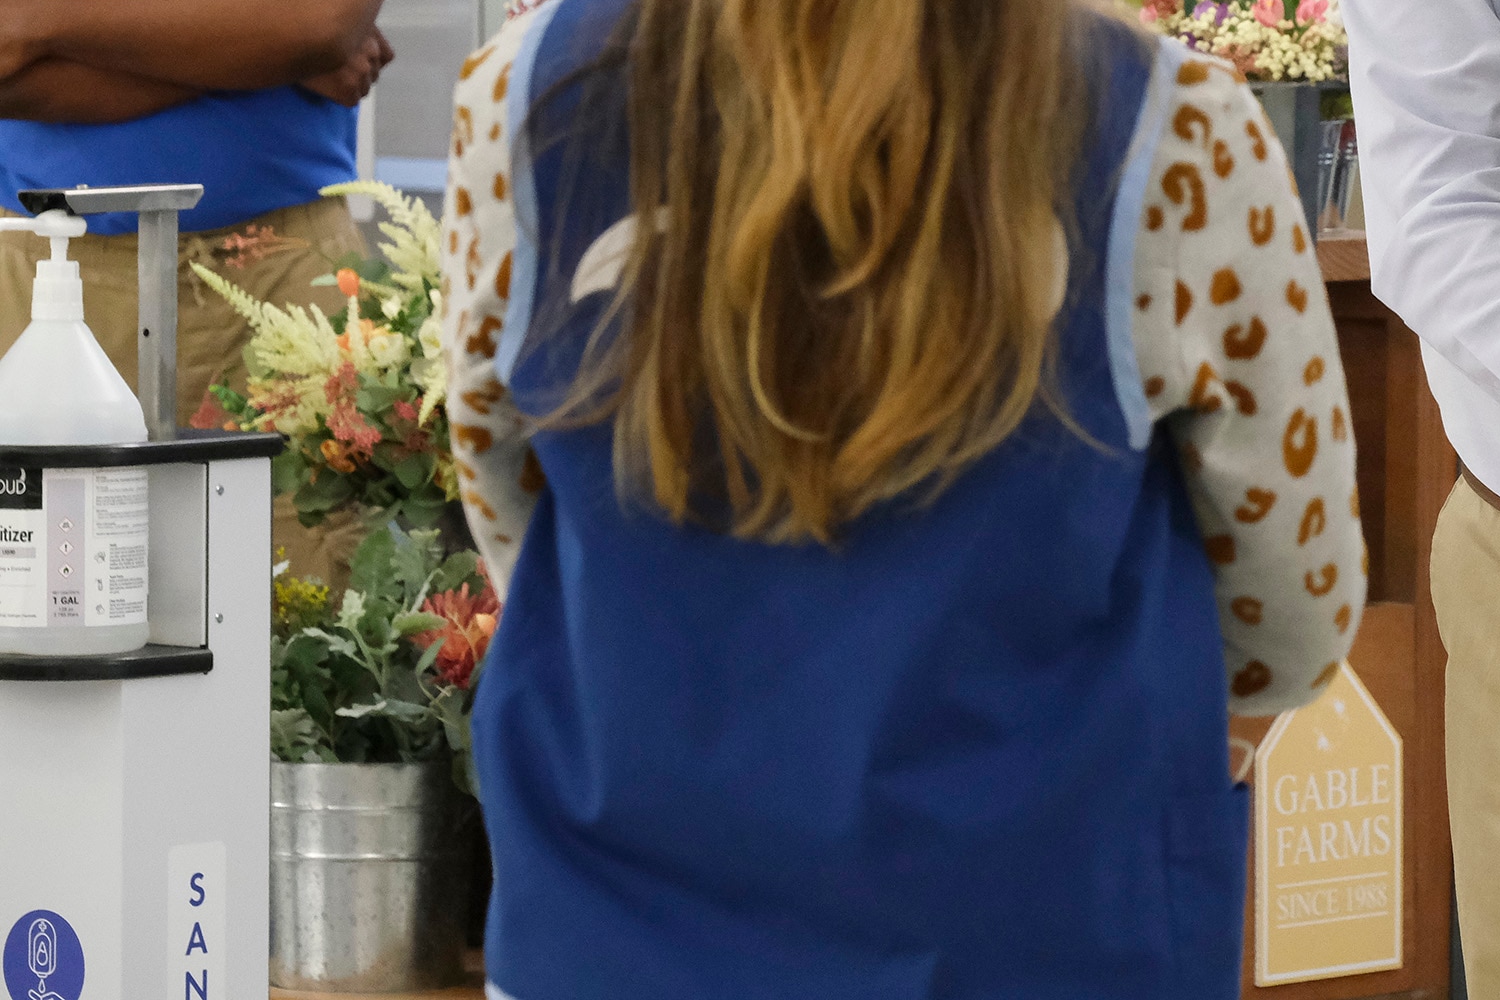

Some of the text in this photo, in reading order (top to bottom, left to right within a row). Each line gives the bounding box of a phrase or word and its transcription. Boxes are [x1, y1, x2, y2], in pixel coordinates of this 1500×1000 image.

[60, 596, 79, 605] GAL
[1273, 764, 1391, 816] GABLE
[1275, 814, 1392, 868] FARMS
[1276, 883, 1388, 921] SINCE 1988
